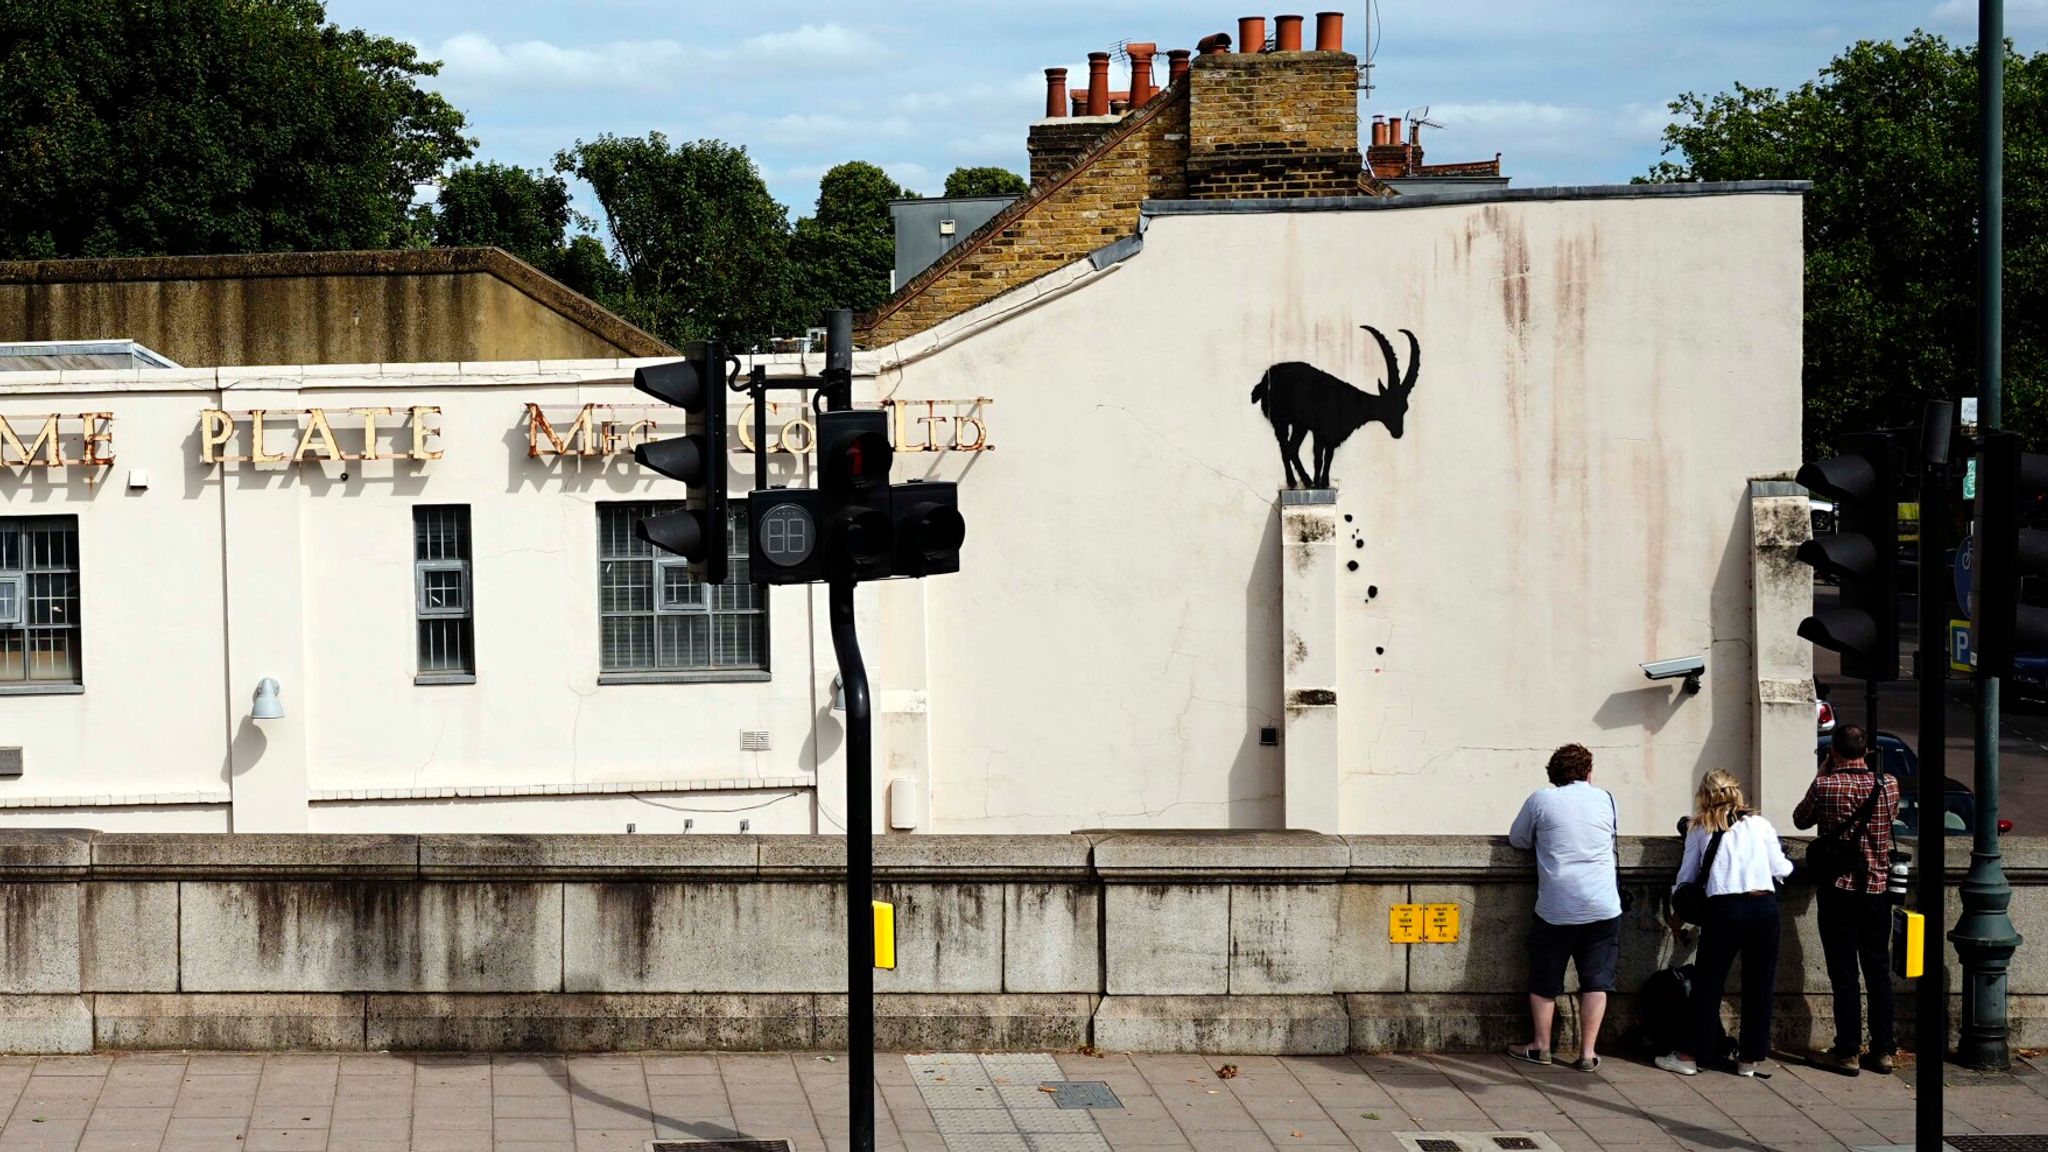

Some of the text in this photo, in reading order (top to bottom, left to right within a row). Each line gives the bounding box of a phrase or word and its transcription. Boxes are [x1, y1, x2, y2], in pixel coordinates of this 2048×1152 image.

[0, 412, 116, 467] ME
[201, 406, 445, 463] PLATE
[881, 399, 987, 452] LTD
[1956, 630, 1969, 660] P
